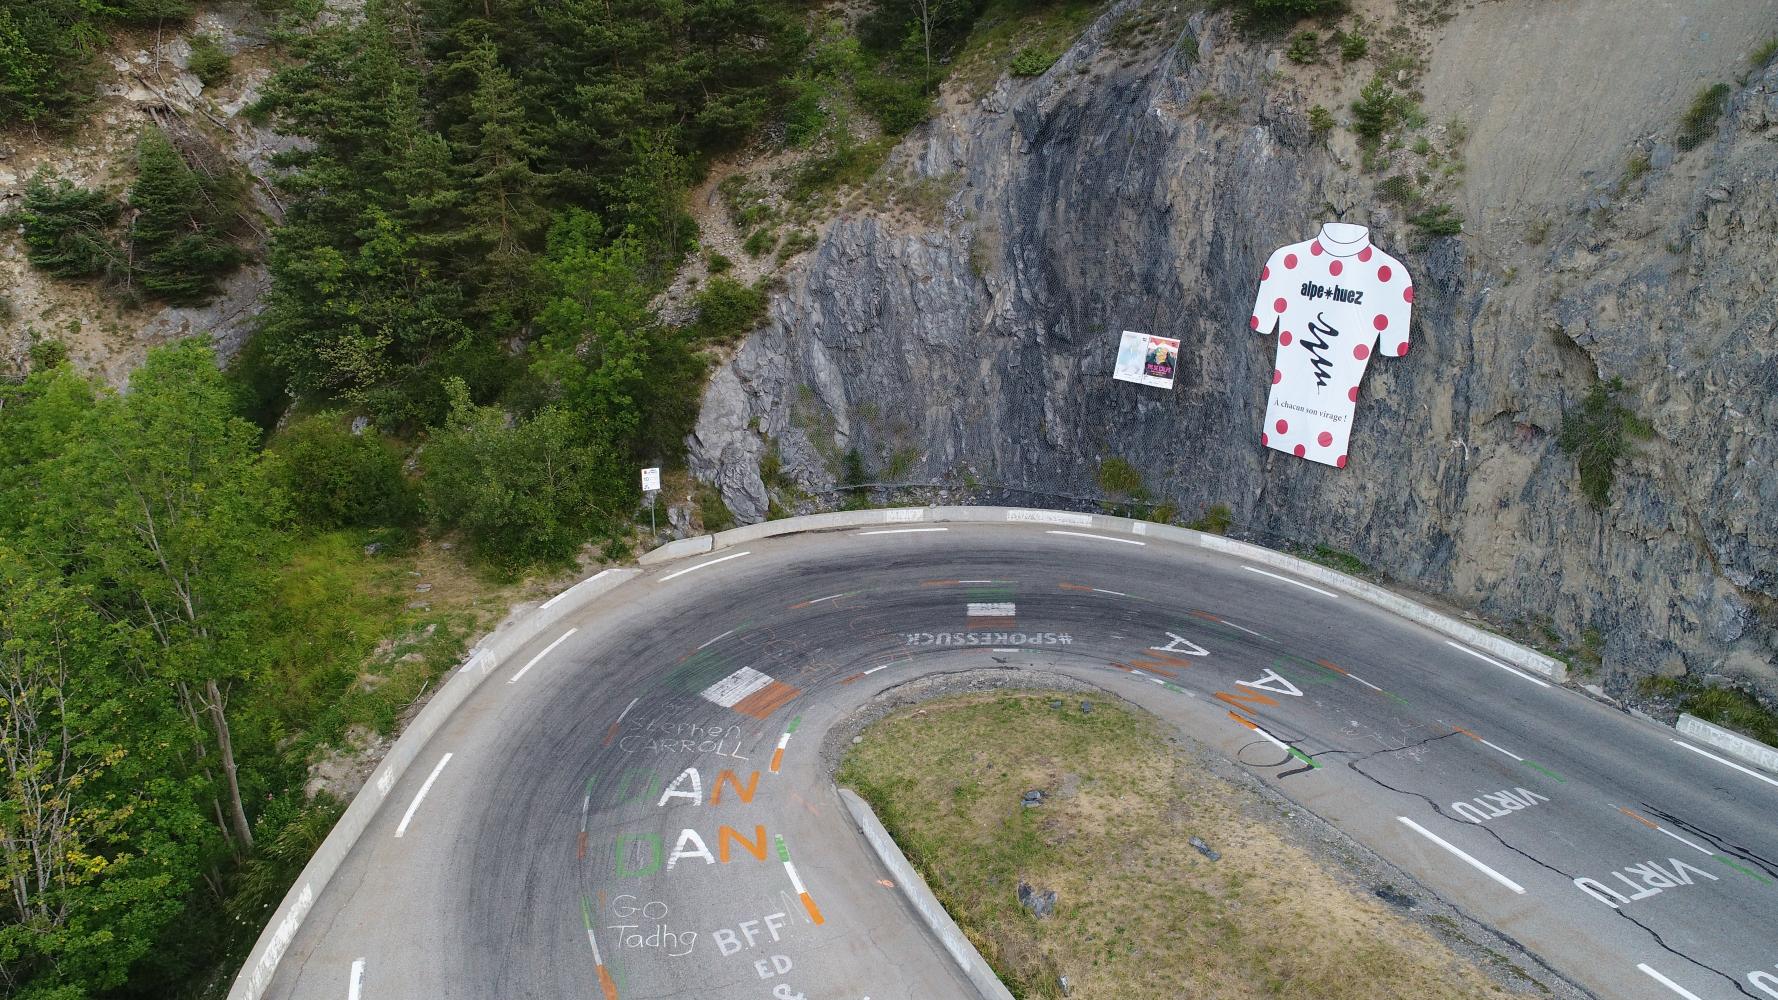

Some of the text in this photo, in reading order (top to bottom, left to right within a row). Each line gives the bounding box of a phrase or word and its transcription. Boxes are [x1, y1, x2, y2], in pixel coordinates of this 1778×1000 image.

[1280, 400, 1304, 414] chacun
[1305, 407, 1318, 416] son
[1319, 410, 1343, 422] virage
[619, 766, 761, 807] DAN
[1451, 787, 1550, 824] VIRTU
[615, 825, 768, 879] DAN
[1573, 857, 1719, 909] VIRTU
[606, 924, 698, 957] Tadhg
[712, 912, 786, 957] BFF
[754, 954, 793, 980] ED
